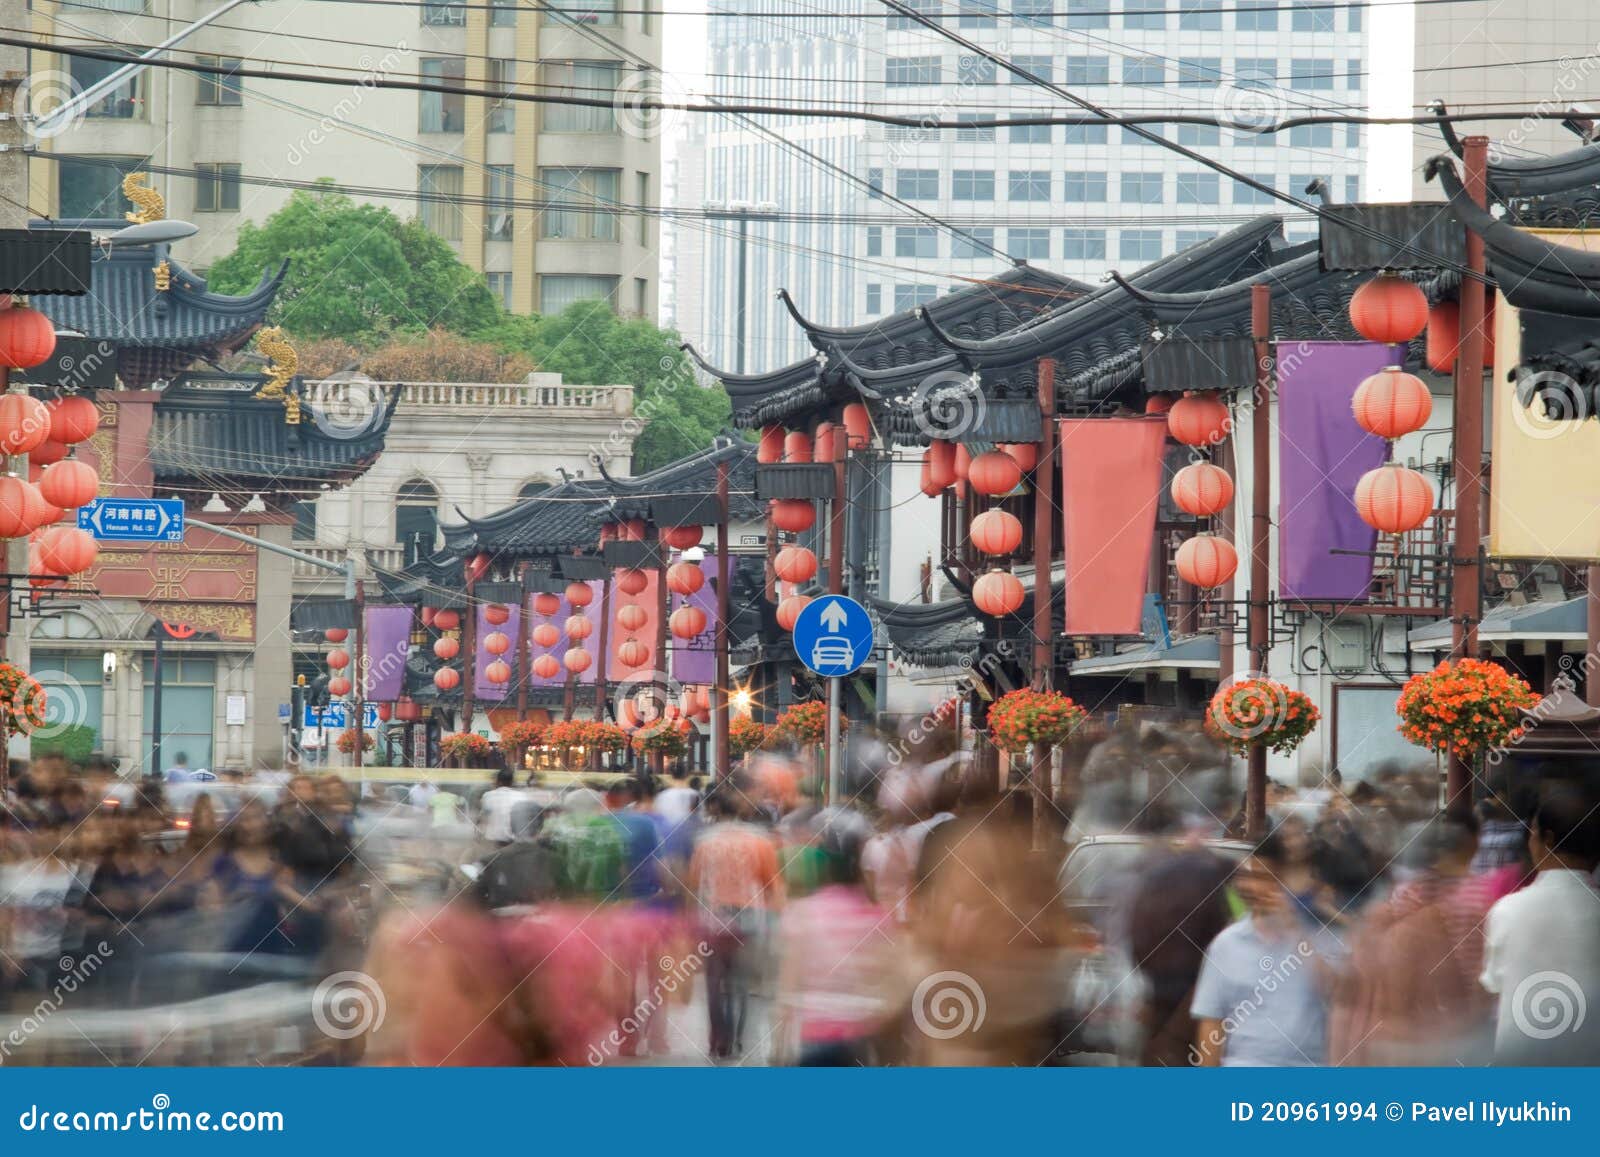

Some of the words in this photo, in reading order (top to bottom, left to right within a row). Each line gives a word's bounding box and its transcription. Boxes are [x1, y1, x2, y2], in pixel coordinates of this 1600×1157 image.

[104, 507, 157, 521] 河南南路
[166, 531, 181, 541] 123
